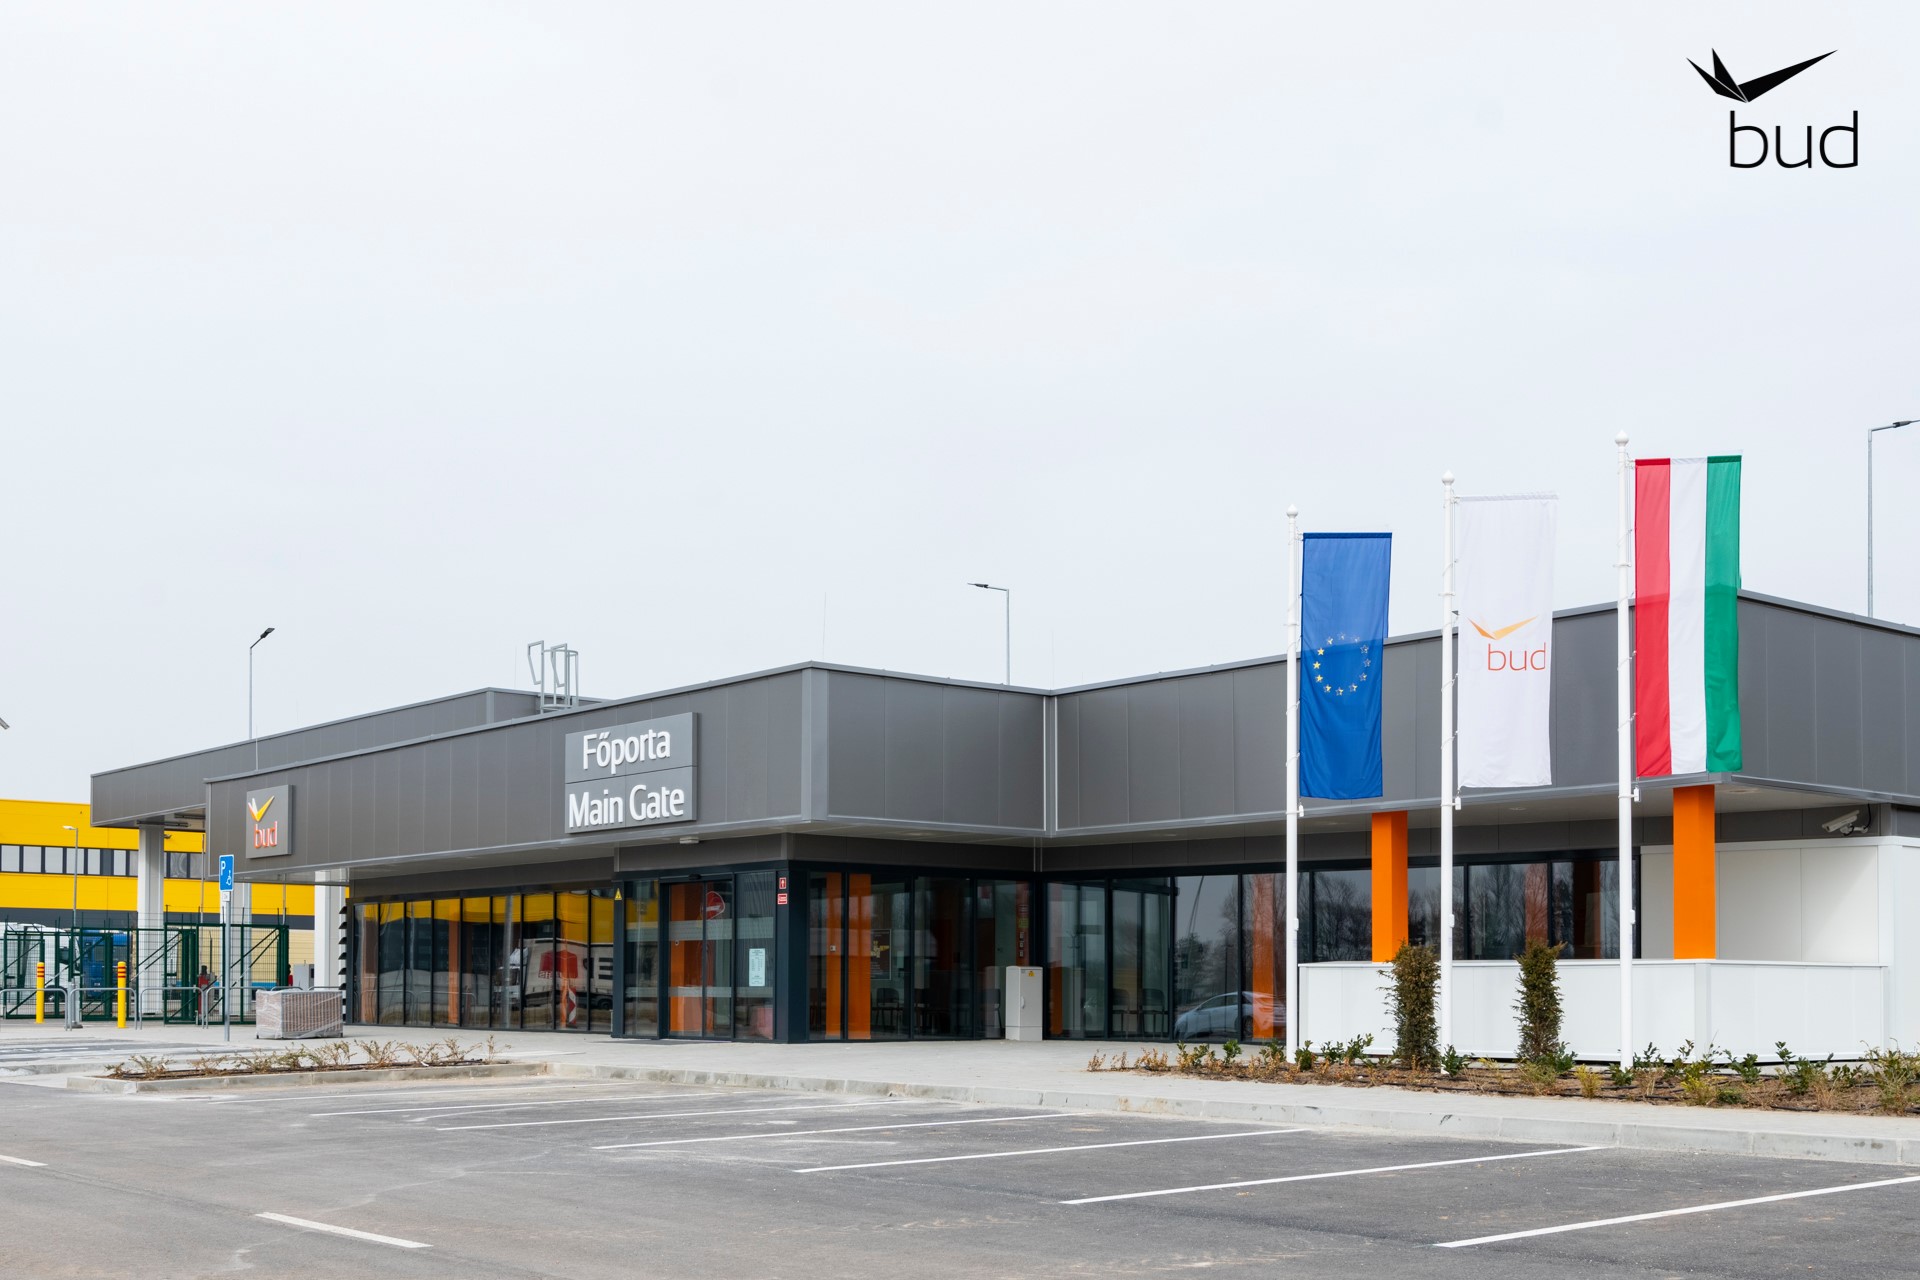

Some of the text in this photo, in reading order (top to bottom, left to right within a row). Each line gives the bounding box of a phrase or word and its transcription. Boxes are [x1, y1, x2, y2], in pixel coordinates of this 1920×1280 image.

[1487, 642, 1546, 671] bud
[583, 729, 671, 775] Főporta
[569, 784, 685, 828] Main Gate
[254, 821, 278, 849] bud
[220, 860, 226, 876] P
